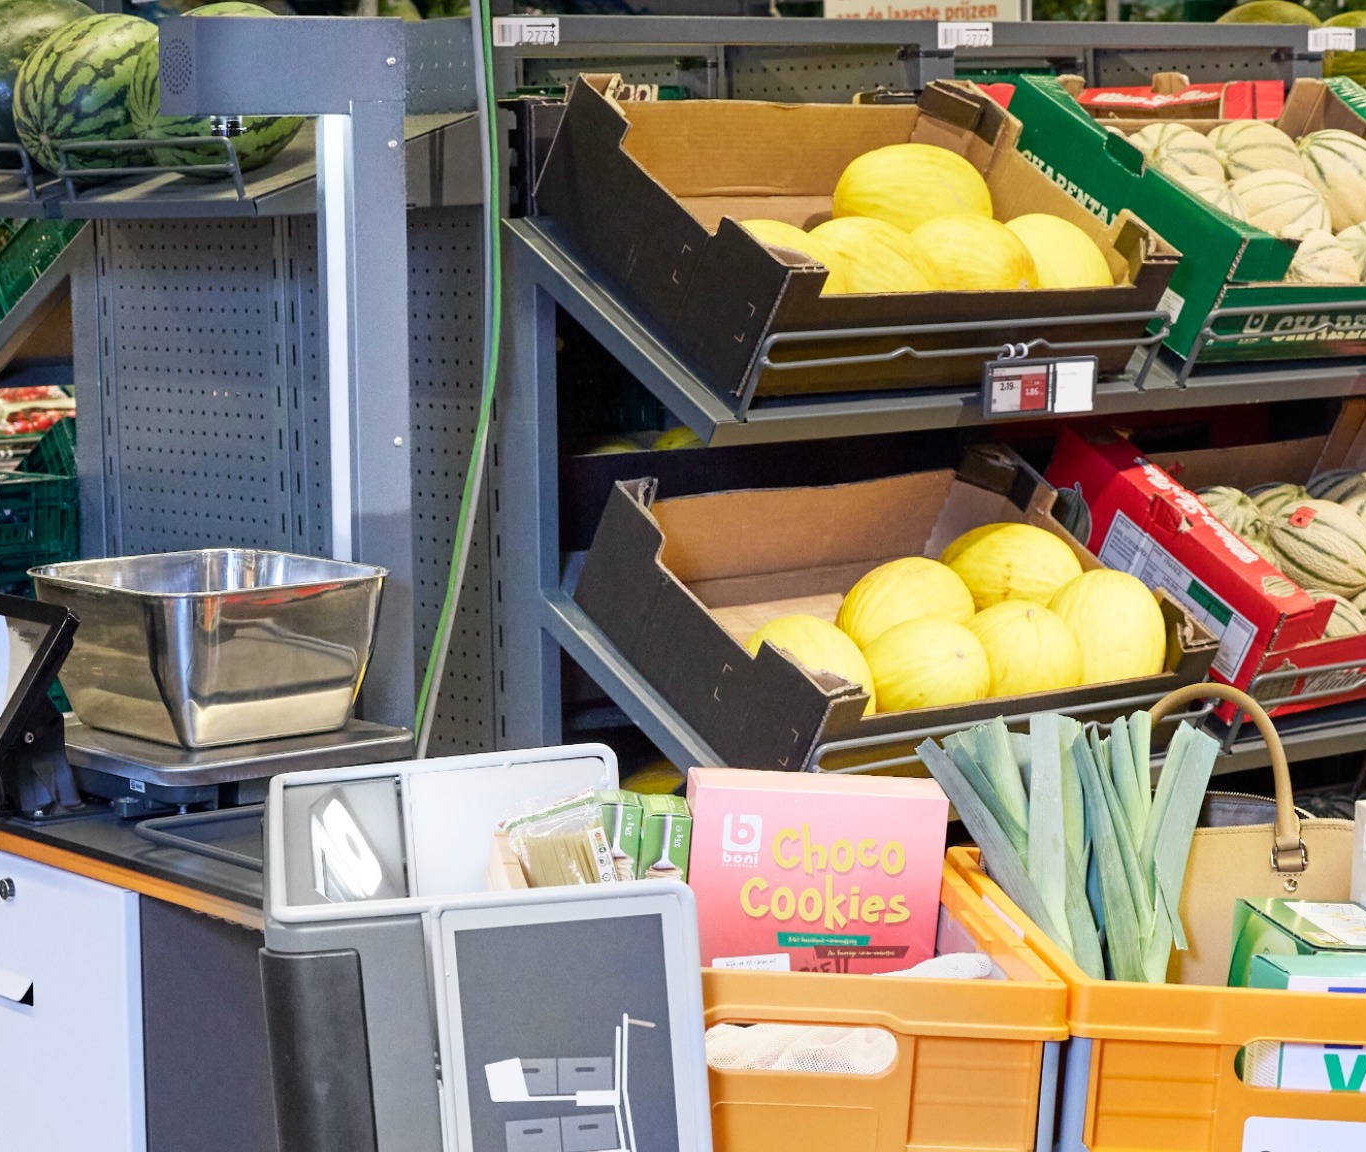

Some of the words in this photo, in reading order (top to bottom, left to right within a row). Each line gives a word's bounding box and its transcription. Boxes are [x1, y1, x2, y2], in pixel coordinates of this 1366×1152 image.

[945, 1, 998, 22] prijzen
[527, 30, 555, 43] 2773
[999, 382, 1015, 392] 2.19
[722, 850, 759, 864] boni
[771, 822, 907, 876] Choco
[739, 874, 912, 931] Cookies
